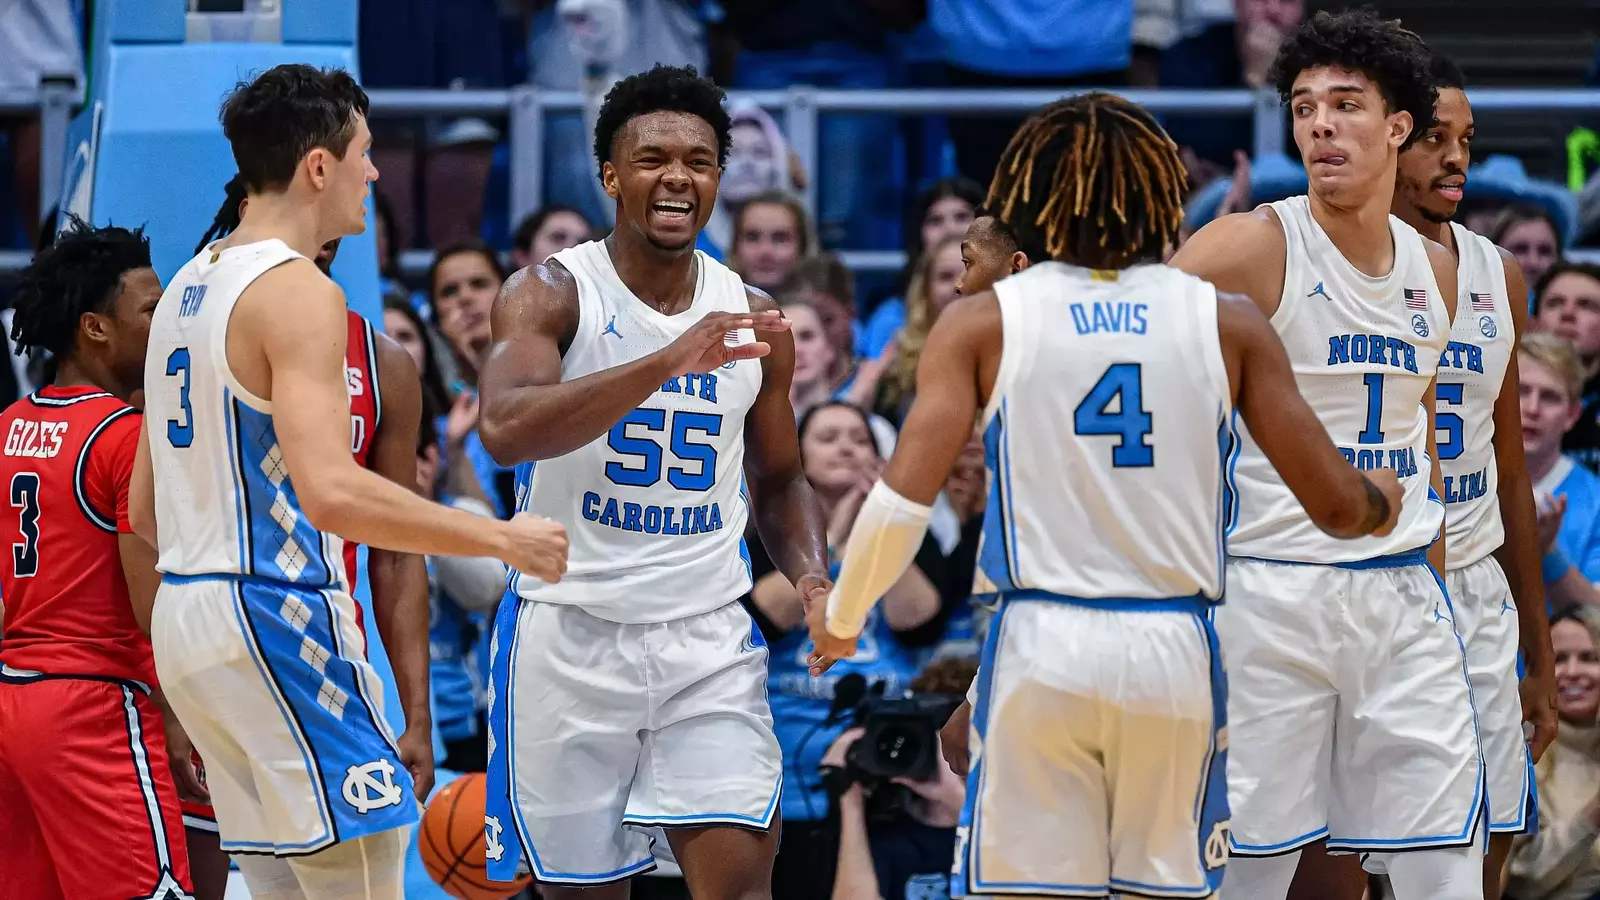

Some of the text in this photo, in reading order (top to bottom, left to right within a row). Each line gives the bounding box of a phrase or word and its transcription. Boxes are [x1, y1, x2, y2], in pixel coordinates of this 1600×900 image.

[178, 284, 208, 318] RYAN
[1069, 301, 1148, 335] DAVIS
[1327, 334, 1419, 374] NORTH
[165, 347, 194, 449] 3
[1073, 362, 1154, 467] 4
[1357, 372, 1385, 445] 1
[4, 417, 69, 459] GILES
[1435, 382, 1465, 461] 5
[604, 407, 724, 492] 55
[1336, 446, 1418, 478] ROLINA
[1443, 466, 1488, 504] LINA
[10, 471, 41, 579] 3
[581, 490, 723, 536] CAROLINA
